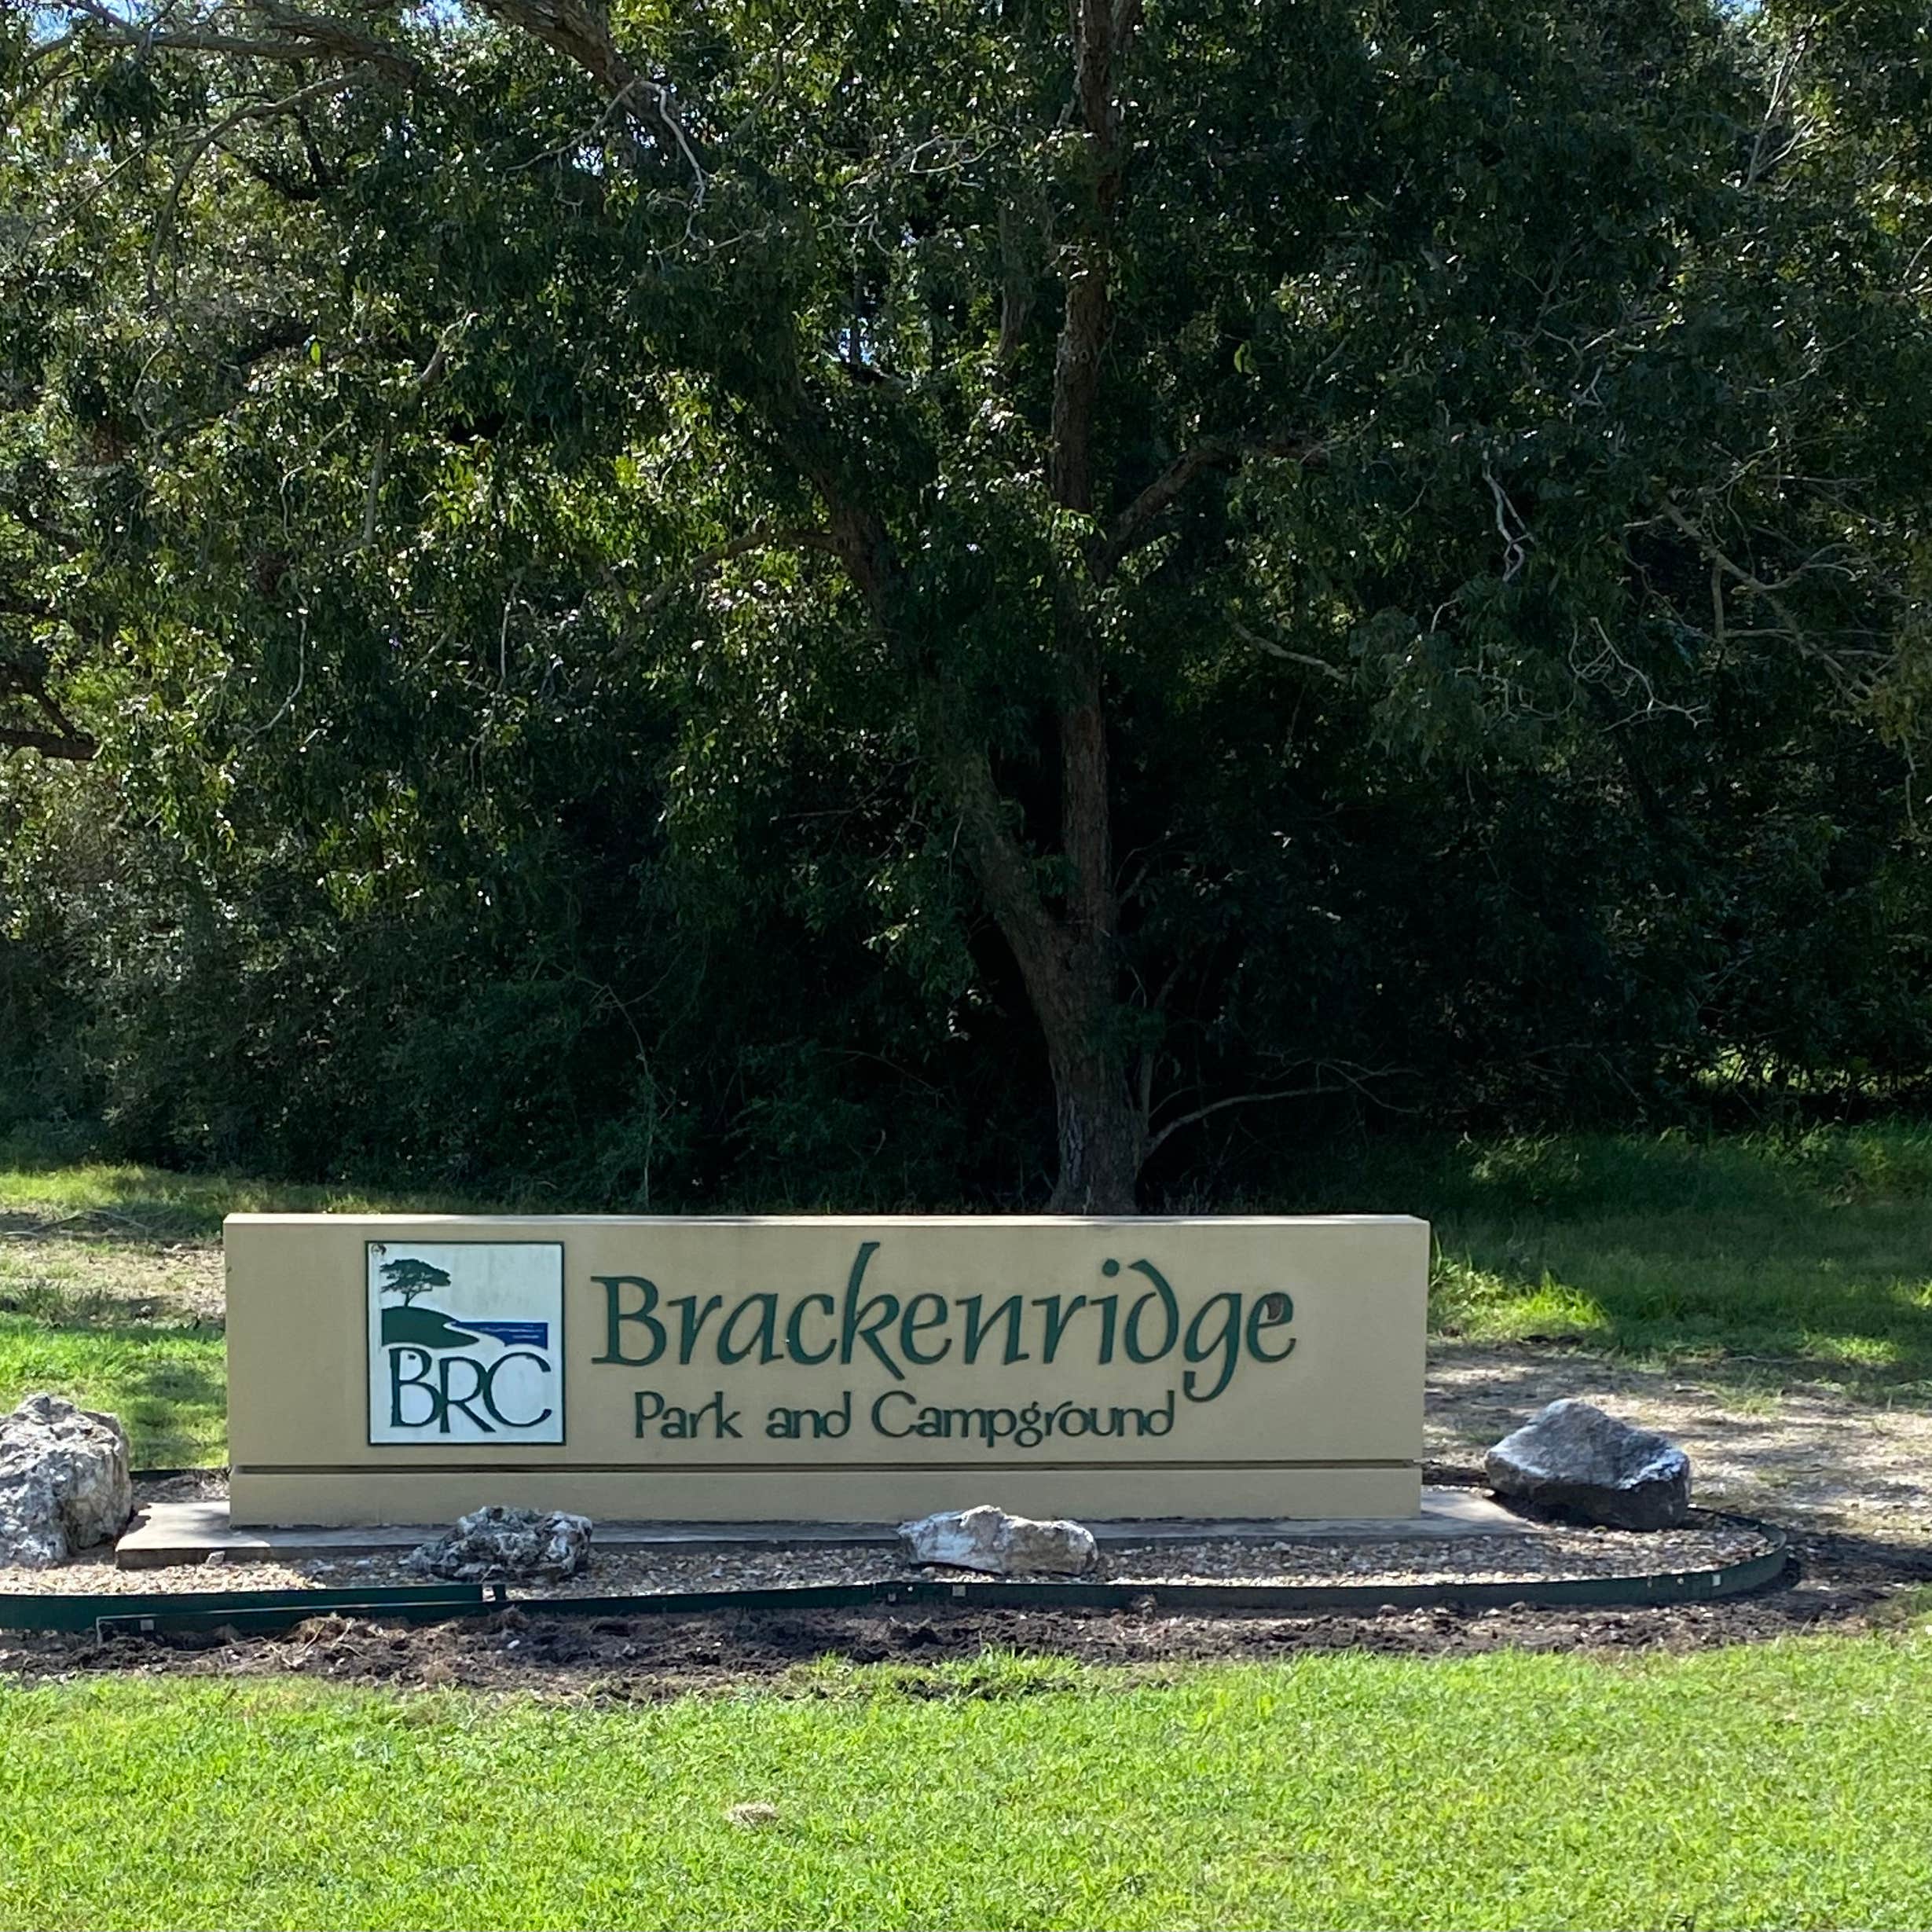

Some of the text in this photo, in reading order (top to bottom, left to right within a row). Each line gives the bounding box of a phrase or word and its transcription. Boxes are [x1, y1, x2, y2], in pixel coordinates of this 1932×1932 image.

[590, 1241, 1297, 1402] Brackenridge
[388, 1347, 552, 1434] BRC
[634, 1389, 1175, 1448] Park and Campground
